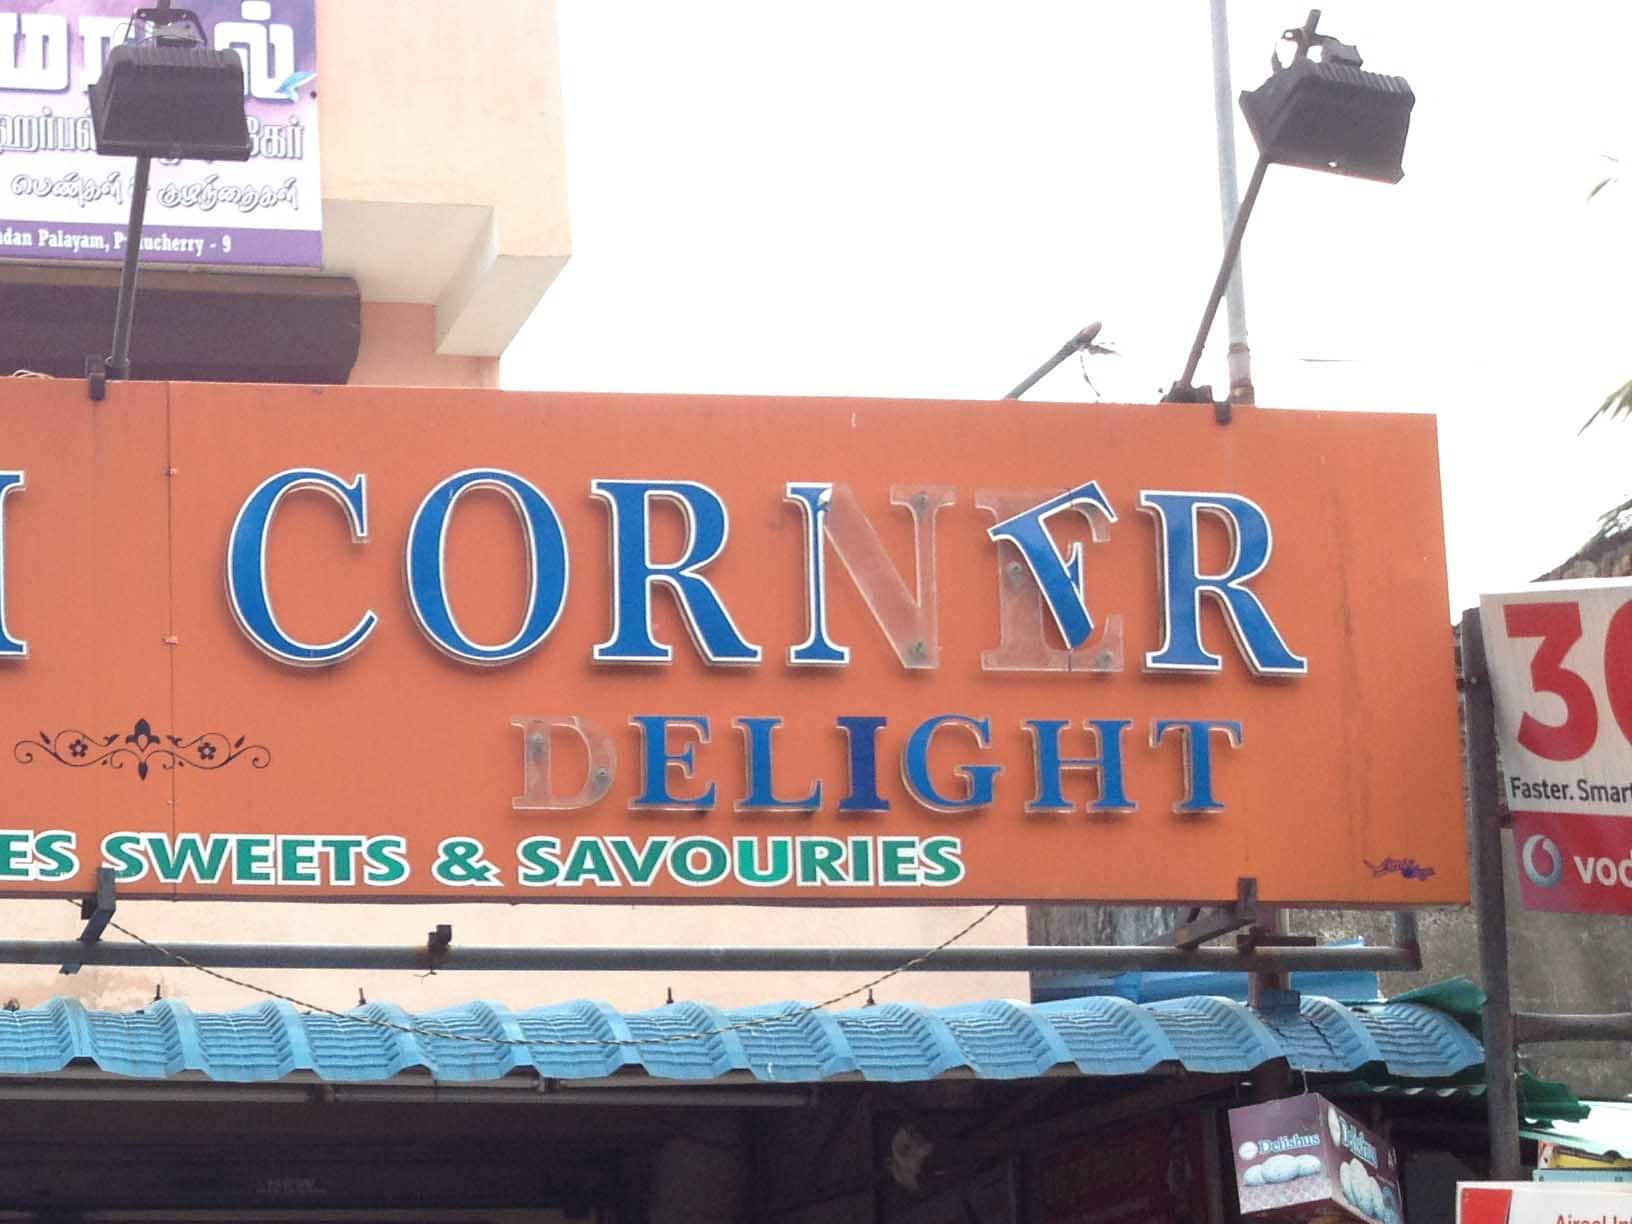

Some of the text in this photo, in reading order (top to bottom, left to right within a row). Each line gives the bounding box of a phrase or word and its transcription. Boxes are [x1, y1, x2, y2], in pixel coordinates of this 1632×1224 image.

[38, 228, 110, 252] Palayam,
[223, 466, 1310, 673] CORNER
[510, 713, 1245, 818] DELIGHT
[1510, 776, 1632, 803] Faster. Smar
[100, 830, 411, 886] SWEETS
[435, 835, 503, 890] &
[512, 834, 965, 889] SAVOURIES
